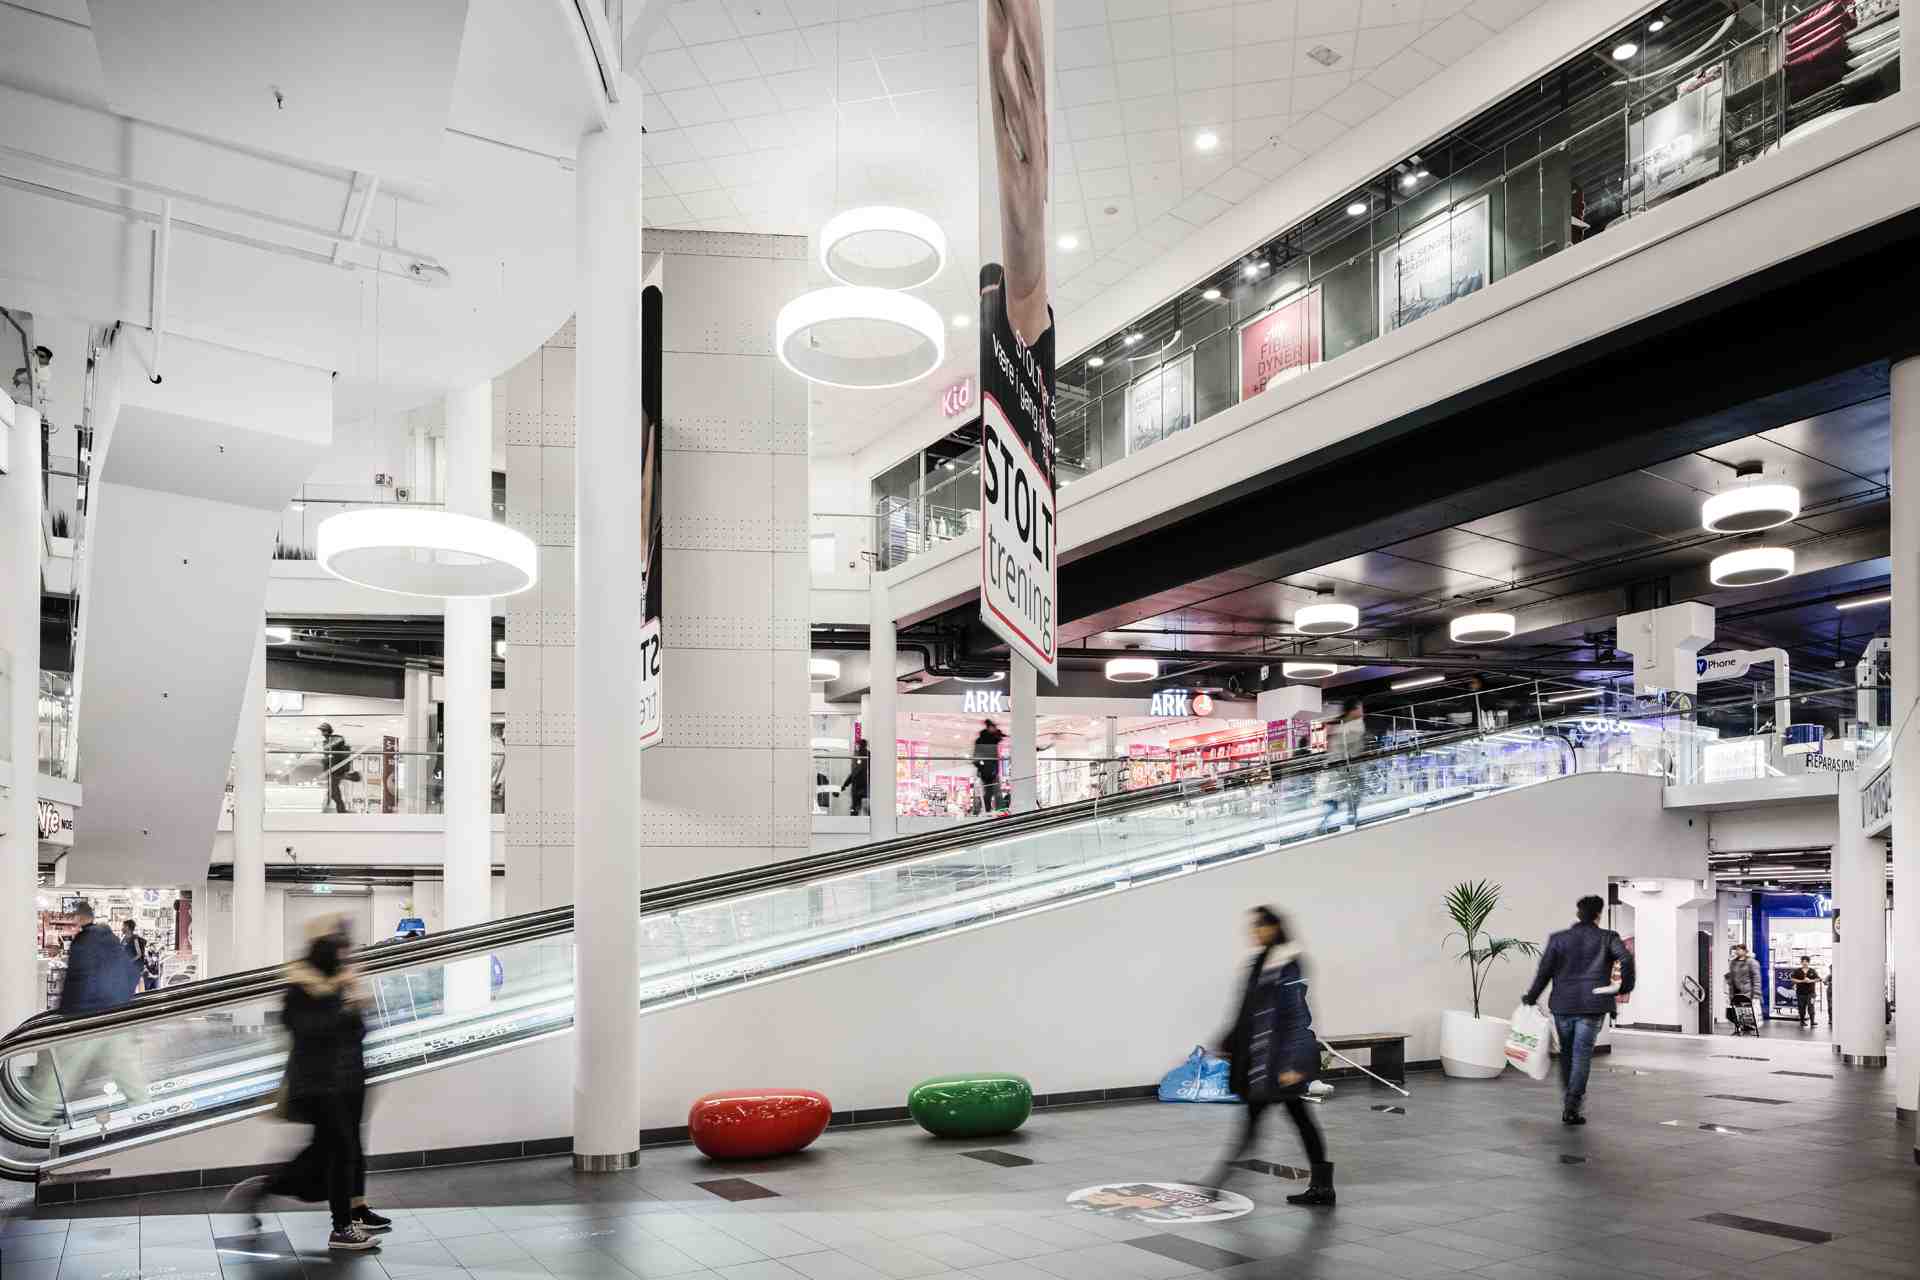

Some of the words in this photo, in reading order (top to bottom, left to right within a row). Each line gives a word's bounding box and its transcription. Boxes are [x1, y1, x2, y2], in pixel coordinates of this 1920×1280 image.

[992, 332, 1015, 386] Være
[1020, 382, 1038, 431] gang
[1016, 329, 1041, 393] STOLT
[943, 378, 970, 415] Kid
[985, 424, 1052, 572] STOLT
[988, 524, 1051, 655] trening
[963, 690, 1002, 713] ARK
[1150, 692, 1188, 716] ARK
[1806, 753, 1855, 773] REPARASJON
